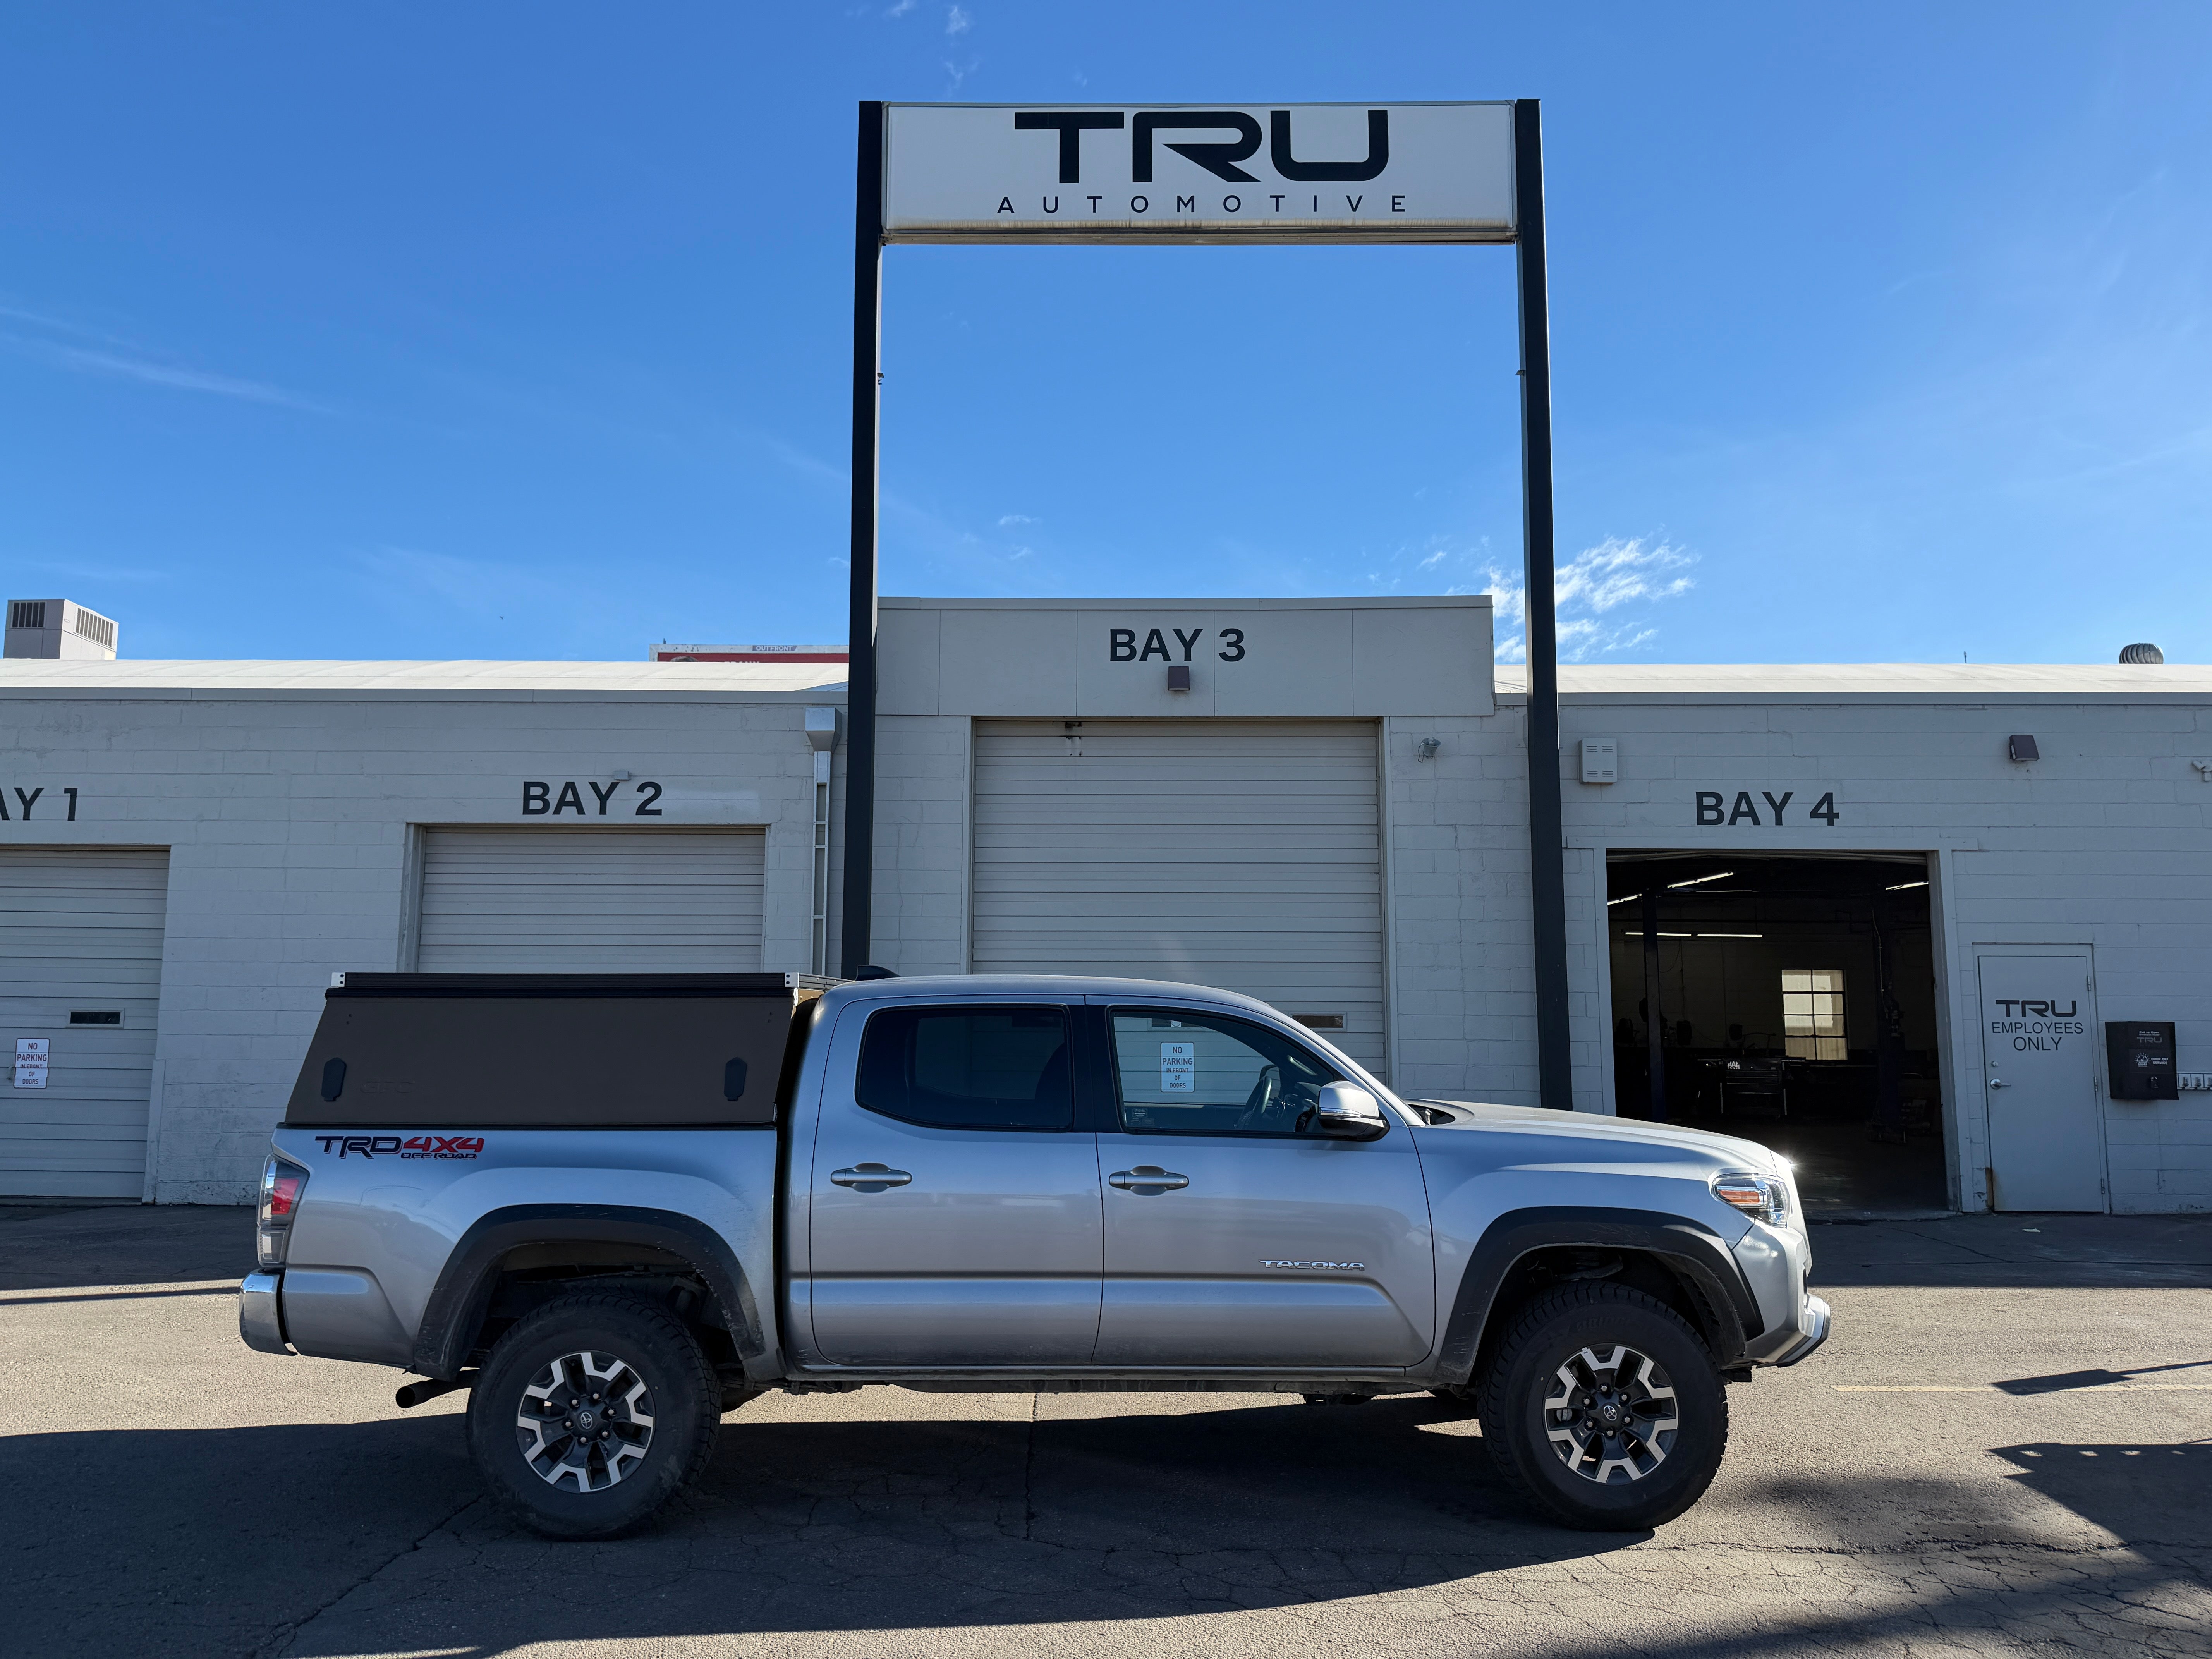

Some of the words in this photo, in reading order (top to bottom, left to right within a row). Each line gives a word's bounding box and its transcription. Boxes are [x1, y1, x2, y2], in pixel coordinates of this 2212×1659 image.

[1015, 110, 1389, 184] TRU
[997, 195, 1406, 214] AUTOMOTIVE
[1110, 629, 1203, 661] BAY
[1218, 628, 1245, 662] 3
[64, 787, 78, 821] 1
[522, 781, 620, 815] BAY
[635, 781, 663, 816] 2
[1695, 791, 1794, 826] BAY
[1810, 792, 1840, 826] 4
[1995, 1000, 2077, 1018] TRU
[1992, 1022, 2083, 1034] EMPLOYEES
[2013, 1037, 2062, 1051] ONLY
[1258, 1259, 1365, 1271] TACOMA
